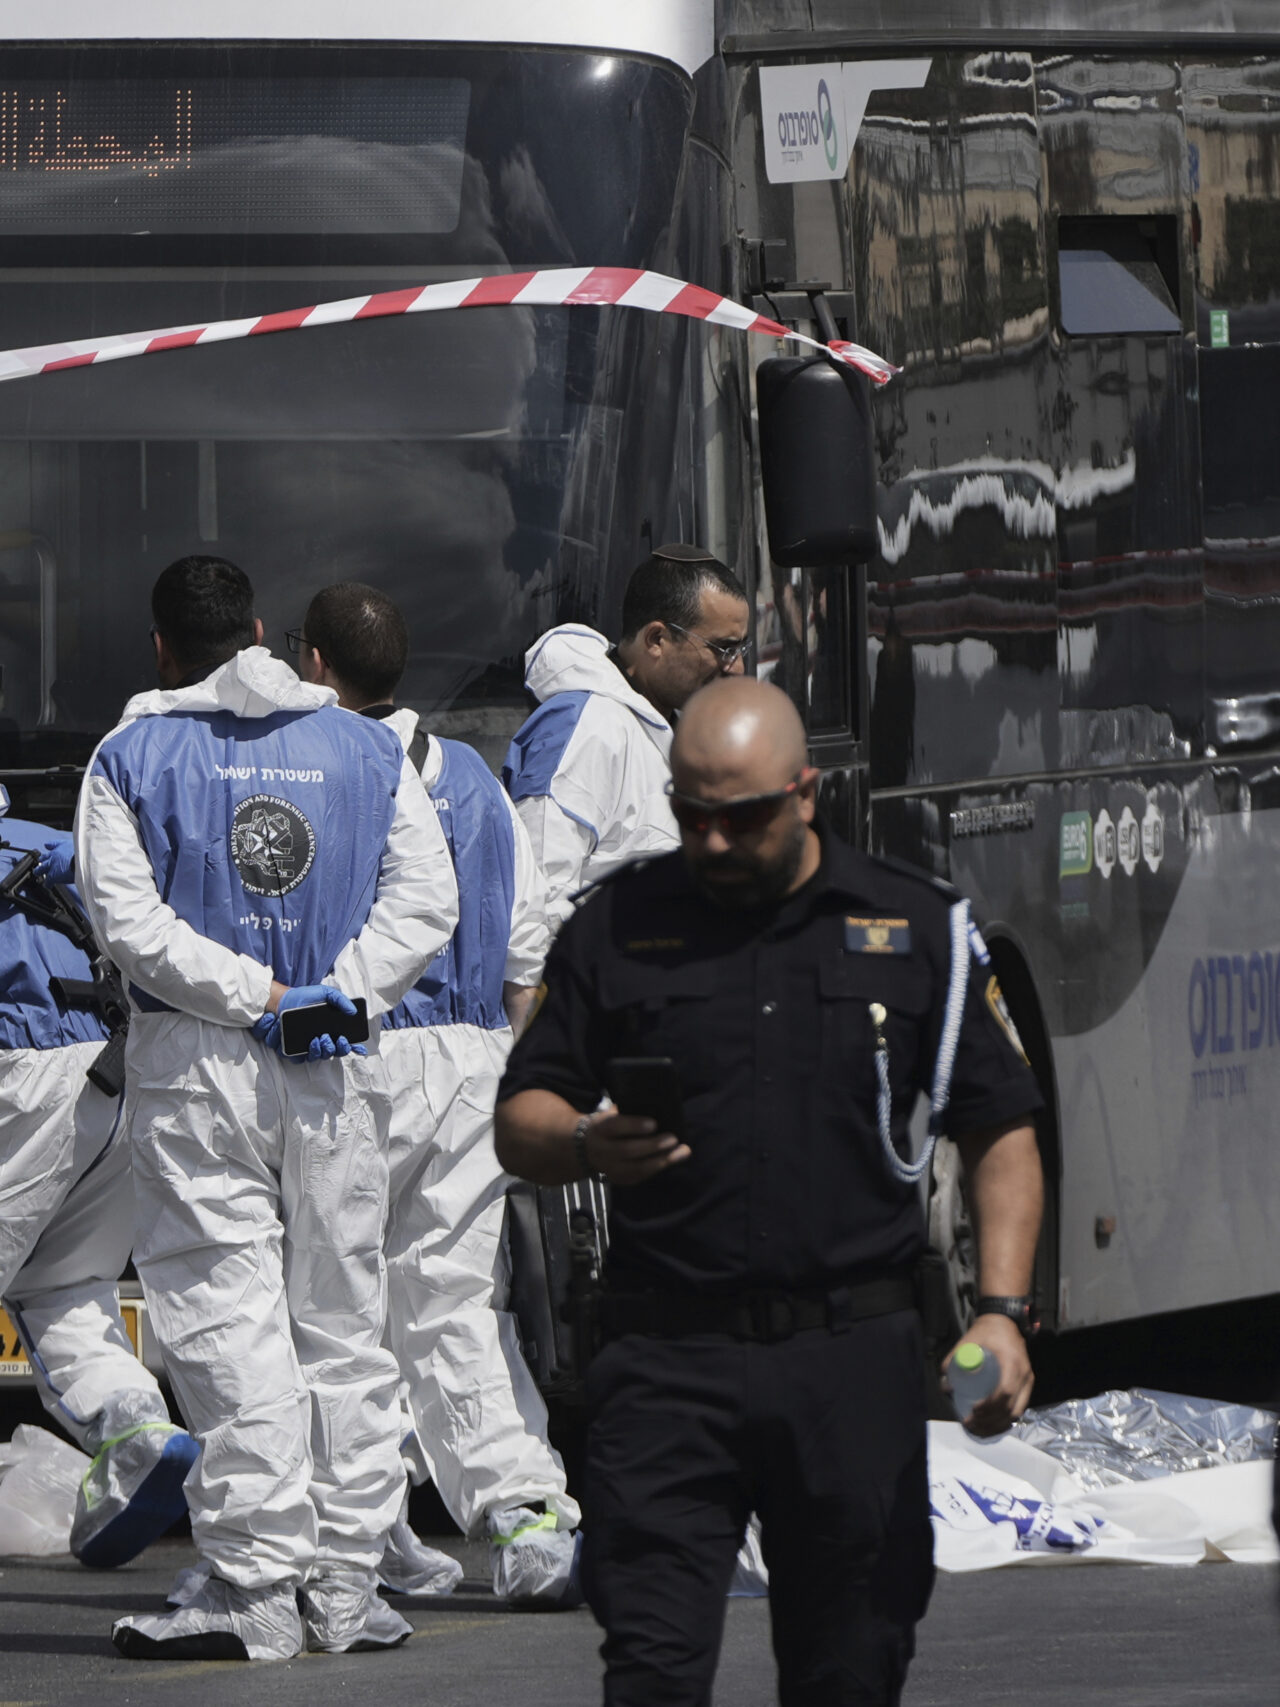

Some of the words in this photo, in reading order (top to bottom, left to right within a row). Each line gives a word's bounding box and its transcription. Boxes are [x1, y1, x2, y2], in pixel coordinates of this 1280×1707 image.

[778, 110, 819, 148] סופרבוס
[260, 767, 324, 782] משטרת
[270, 797, 307, 822] FORENSIC
[303, 821, 316, 857] SCIENCE
[1188, 951, 1280, 1060] ופרבוס
